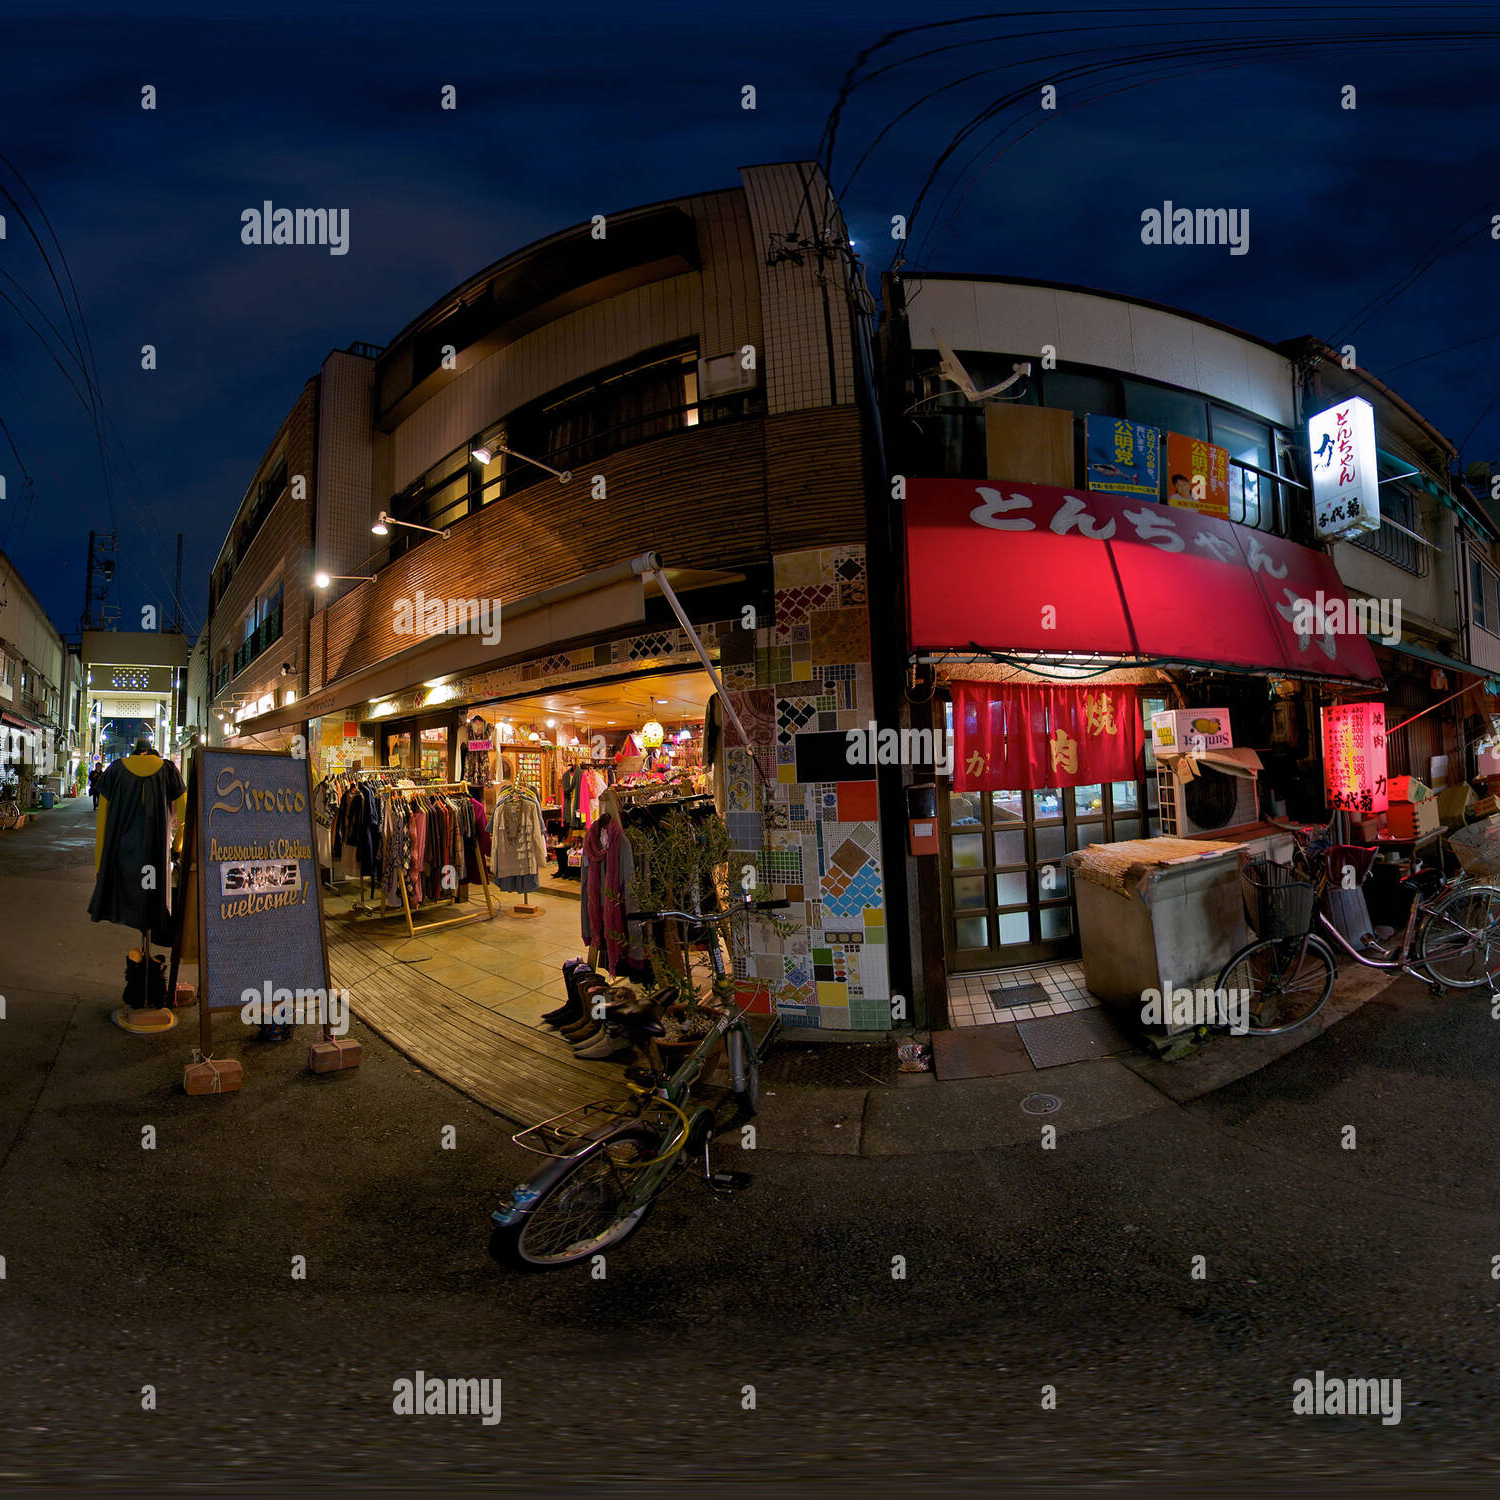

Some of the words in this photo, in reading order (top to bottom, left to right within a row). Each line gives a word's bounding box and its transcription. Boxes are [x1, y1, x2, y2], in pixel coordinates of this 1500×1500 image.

[1114, 421, 1134, 466] 公明党
[1336, 409, 1356, 487] とんちゃん
[970, 487, 1288, 579] とんちゃん
[1373, 711, 1384, 749] 焼肉
[208, 766, 307, 828] Sirocco
[1375, 775, 1387, 797] 力
[269, 840, 277, 859] &
[277, 838, 312, 860] Clothes
